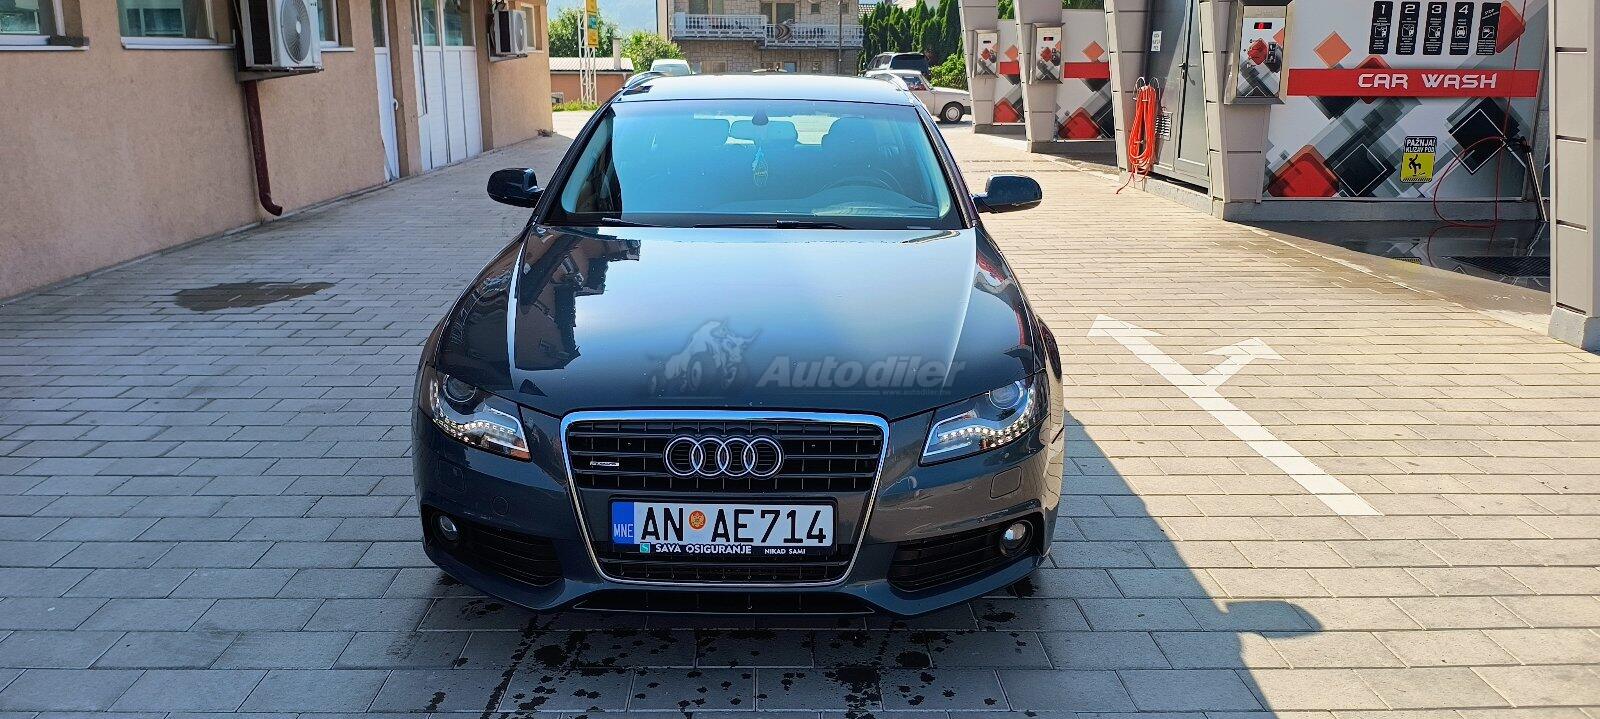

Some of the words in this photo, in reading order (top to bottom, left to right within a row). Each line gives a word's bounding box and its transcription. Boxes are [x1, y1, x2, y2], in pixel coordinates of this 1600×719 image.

[1381, 4, 1386, 15] 1
[1404, 4, 1416, 14] 2
[1431, 4, 1442, 14] 3
[1458, 4, 1469, 15] 4
[1357, 73, 1409, 90] CAR
[1421, 72, 1498, 90] WASH
[613, 523, 634, 539] MNE
[640, 506, 684, 542] AN
[711, 508, 827, 544] AE714
[655, 543, 682, 553] SAVA
[685, 544, 752, 555] OSIGURANJE
